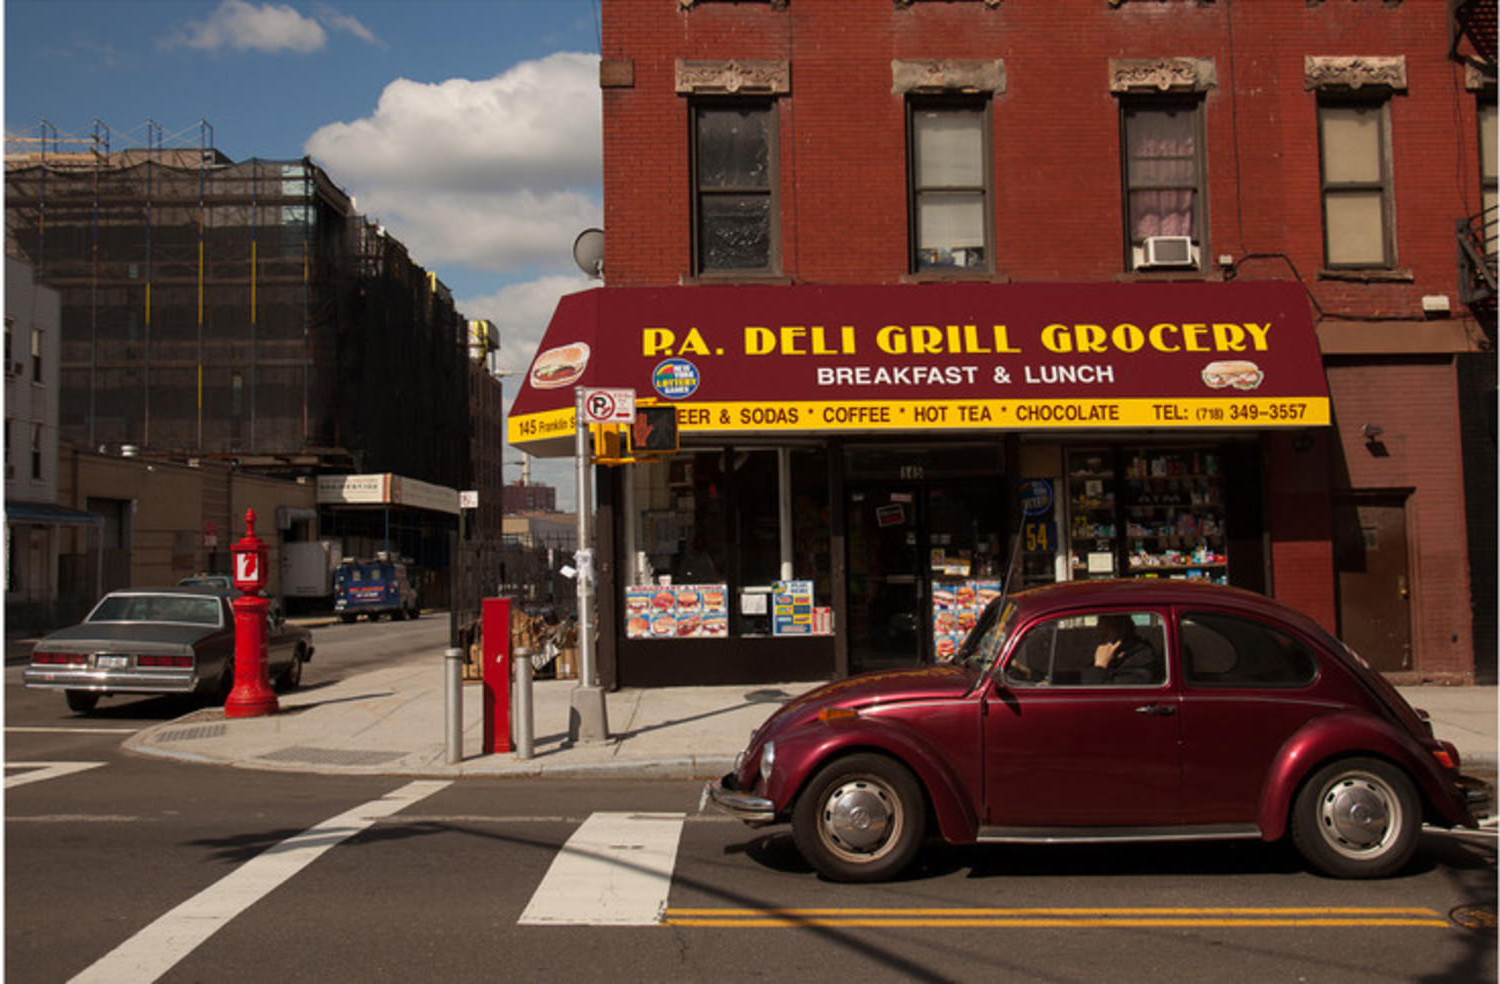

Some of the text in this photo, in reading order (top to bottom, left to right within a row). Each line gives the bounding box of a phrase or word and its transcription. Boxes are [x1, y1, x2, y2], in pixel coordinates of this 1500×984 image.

[745, 326, 856, 355] DELI
[875, 324, 1021, 354] GRILL
[1041, 322, 1272, 354] GROCERY
[816, 364, 1114, 386] BREAKFAST & LUNCH
[677, 403, 1308, 425] EER & SODAS COFFEE HOT TEA CHOCOLATE TEL: (718) 349-3557
[519, 420, 537, 436] 145
[539, 418, 568, 433] Franklin
[1026, 521, 1049, 551] 54
